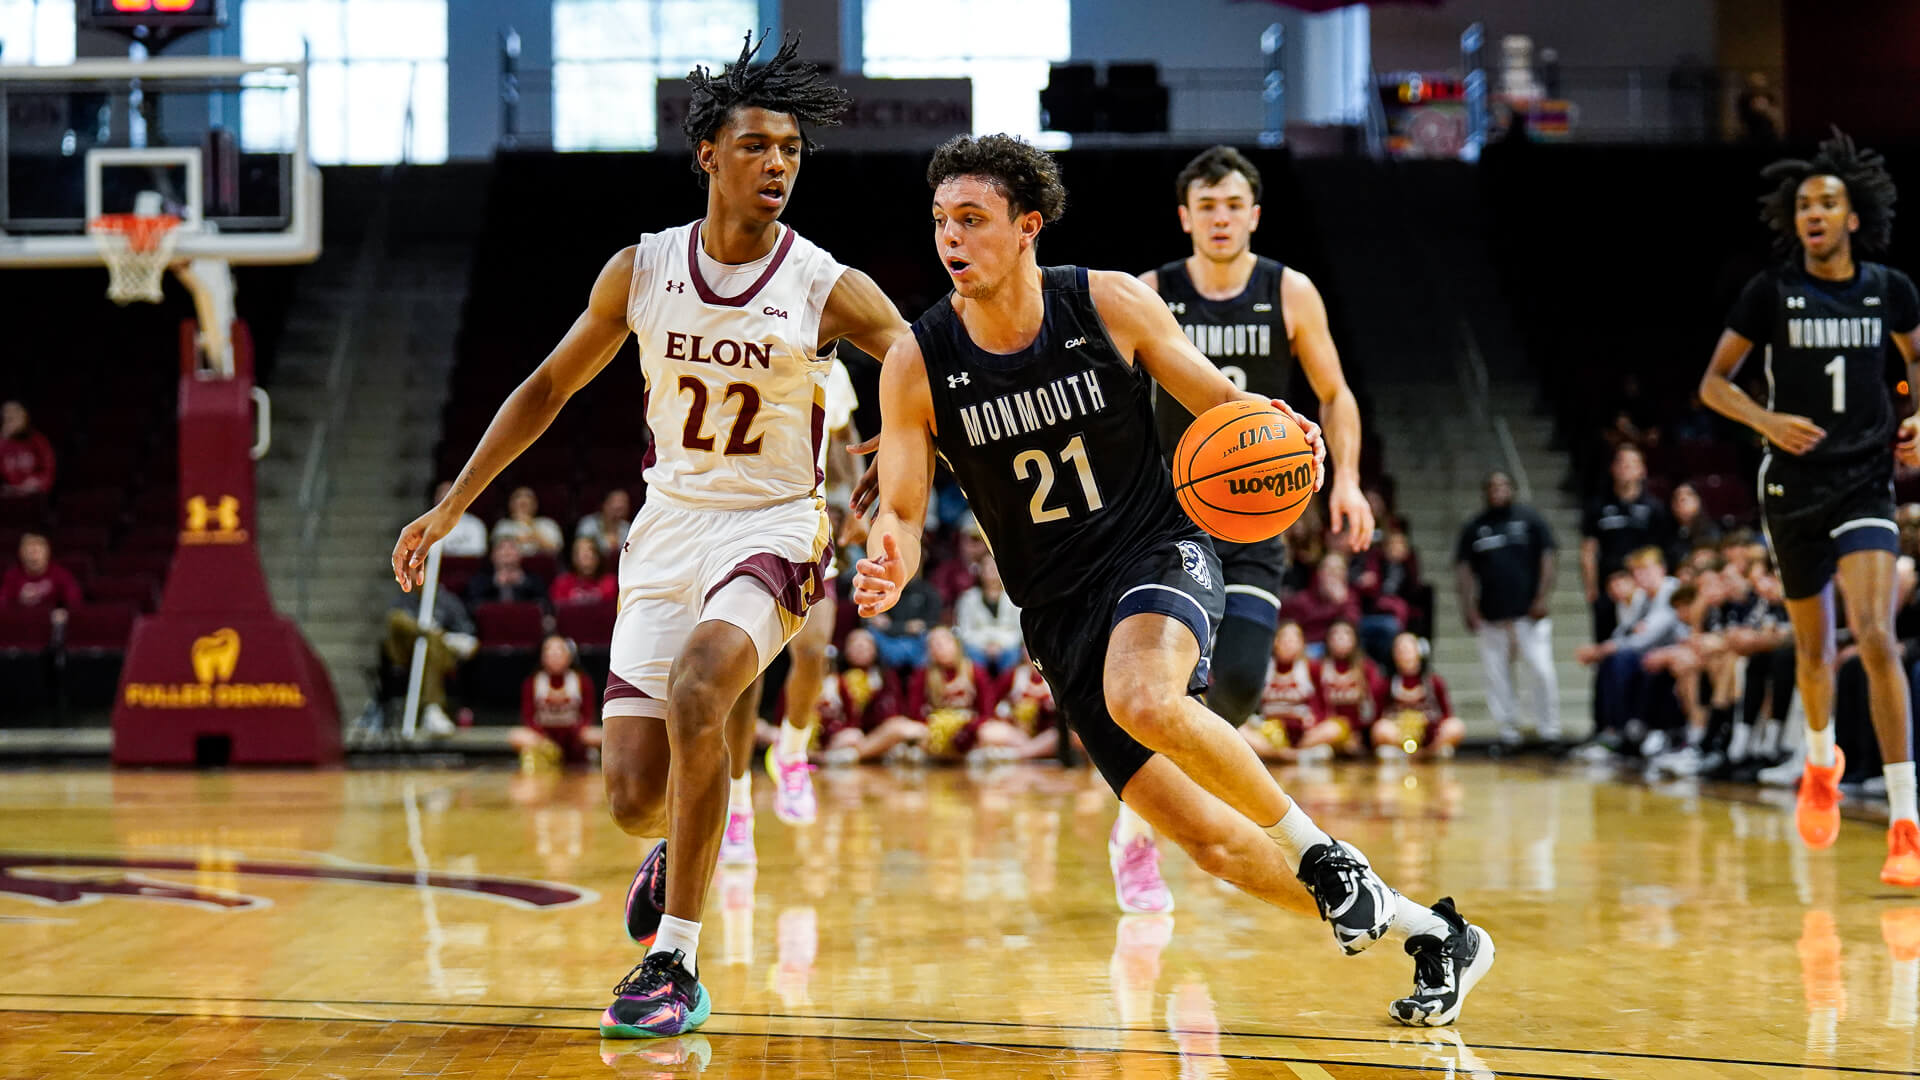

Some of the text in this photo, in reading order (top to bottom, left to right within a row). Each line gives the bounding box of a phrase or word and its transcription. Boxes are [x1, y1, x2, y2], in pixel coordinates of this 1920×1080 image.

[763, 306, 789, 320] CAA
[664, 331, 774, 369] ELON
[1064, 336, 1087, 349] CAA
[1180, 324, 1271, 357] ONMOUTH
[1824, 355, 1846, 413] 1
[677, 375, 766, 456] 22
[959, 369, 1107, 446] MONMOUTH
[1222, 445, 1239, 458] NXT
[1012, 434, 1105, 525] 21
[1228, 462, 1312, 497] Wilson
